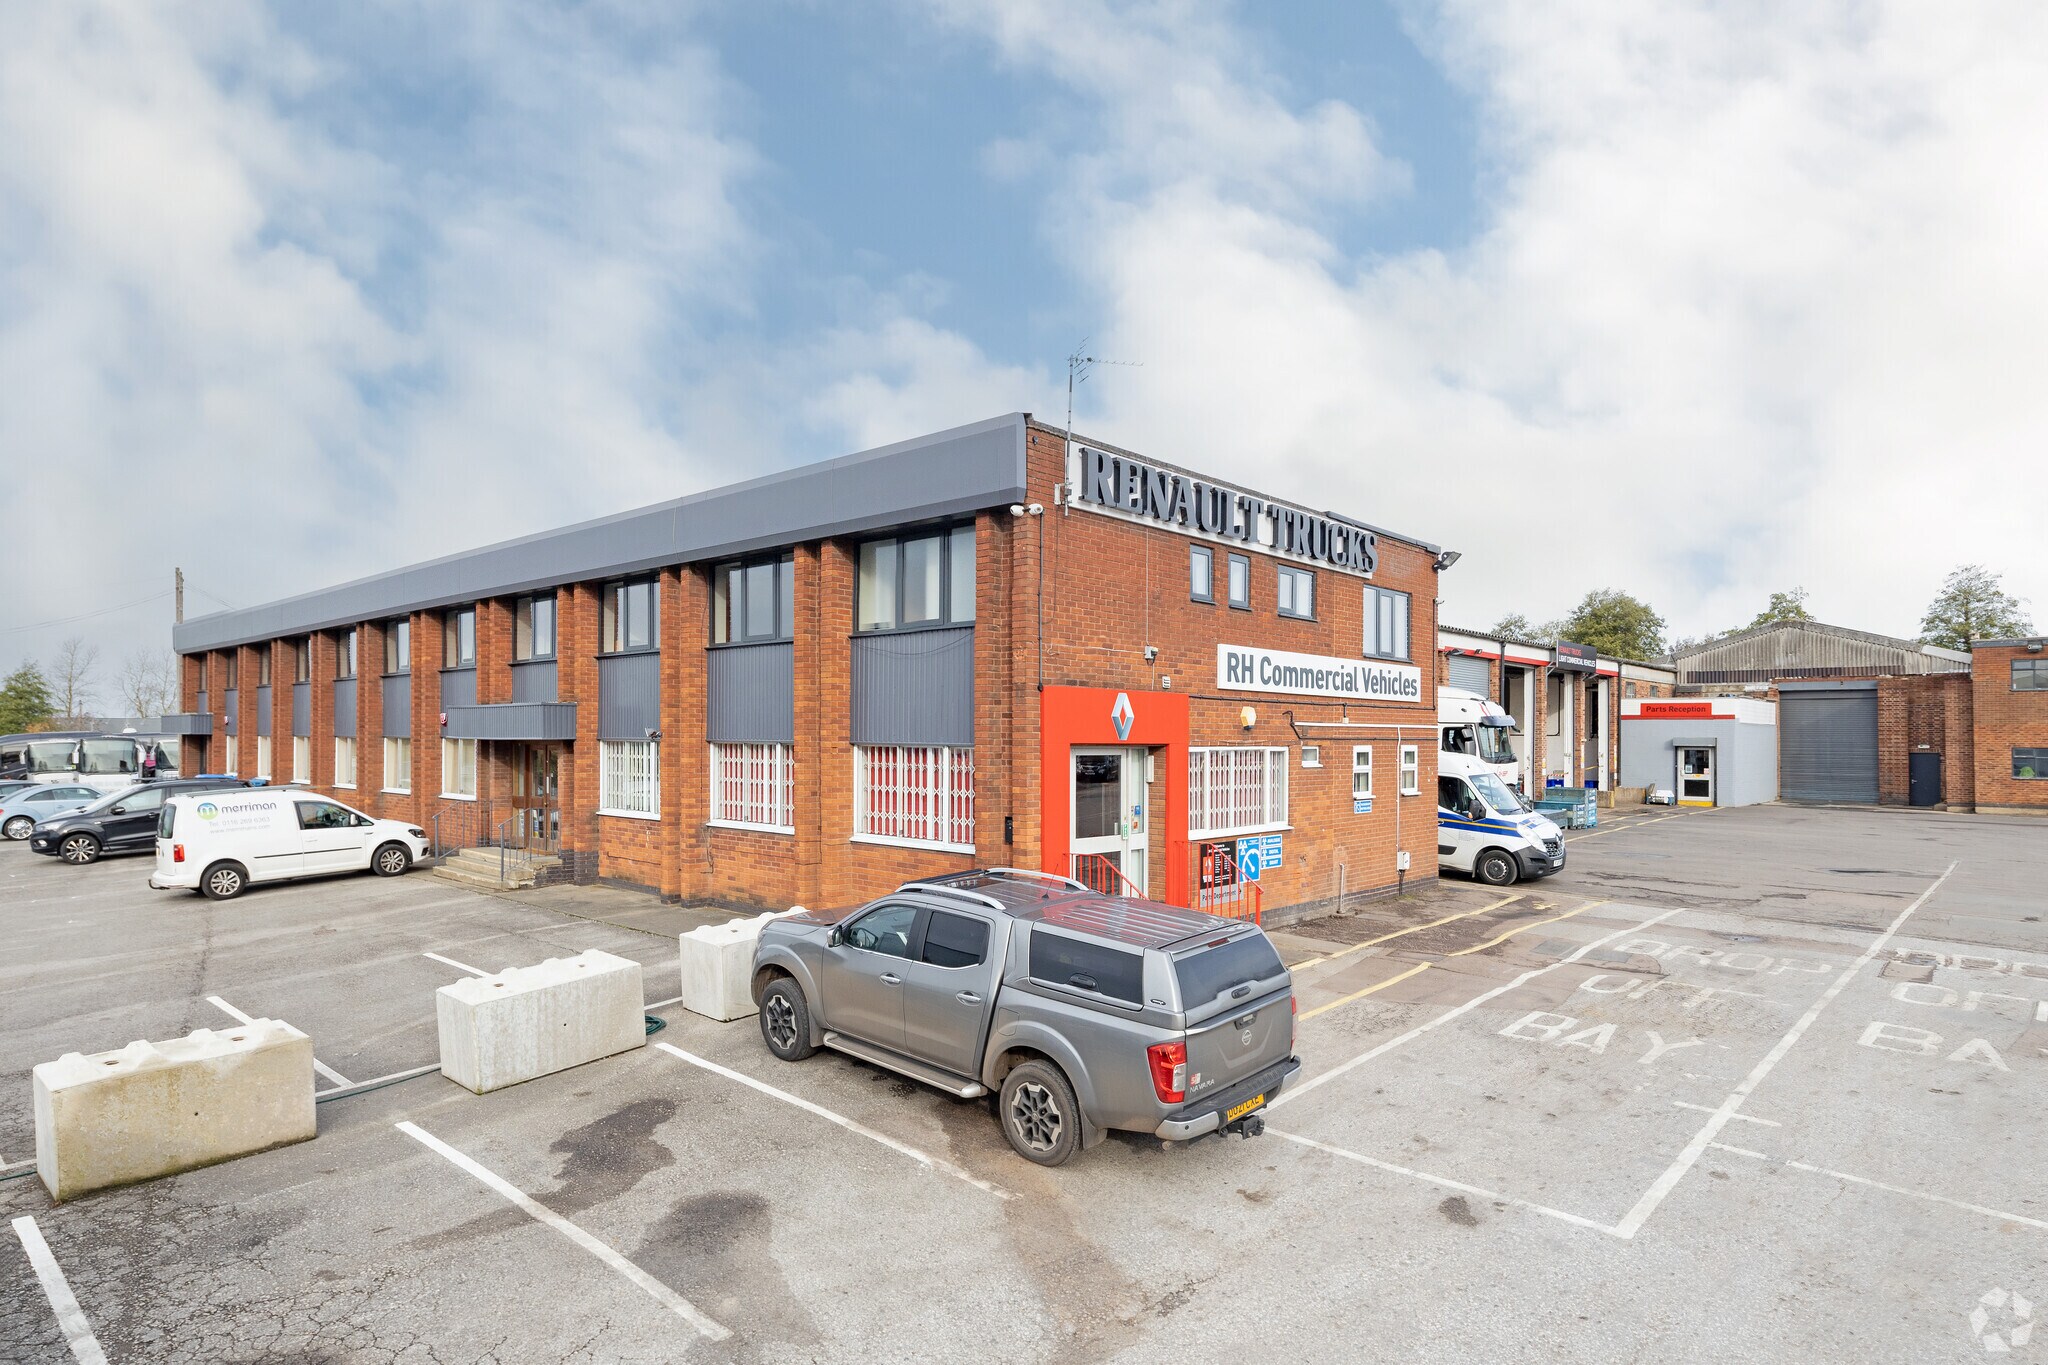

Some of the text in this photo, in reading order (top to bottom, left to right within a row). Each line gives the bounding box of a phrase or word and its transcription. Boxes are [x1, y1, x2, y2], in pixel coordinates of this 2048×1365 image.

[1079, 447, 1379, 573] RENAULT TRUCKS
[1227, 652, 1417, 697] RH Commercial Vehicles
[1668, 705, 1706, 714] Reception
[221, 802, 277, 814] merriman
[1497, 1010, 1706, 1065] BAY
[1858, 1021, 2048, 1072] BA
[1190, 1078, 1215, 1093] NAVARA
